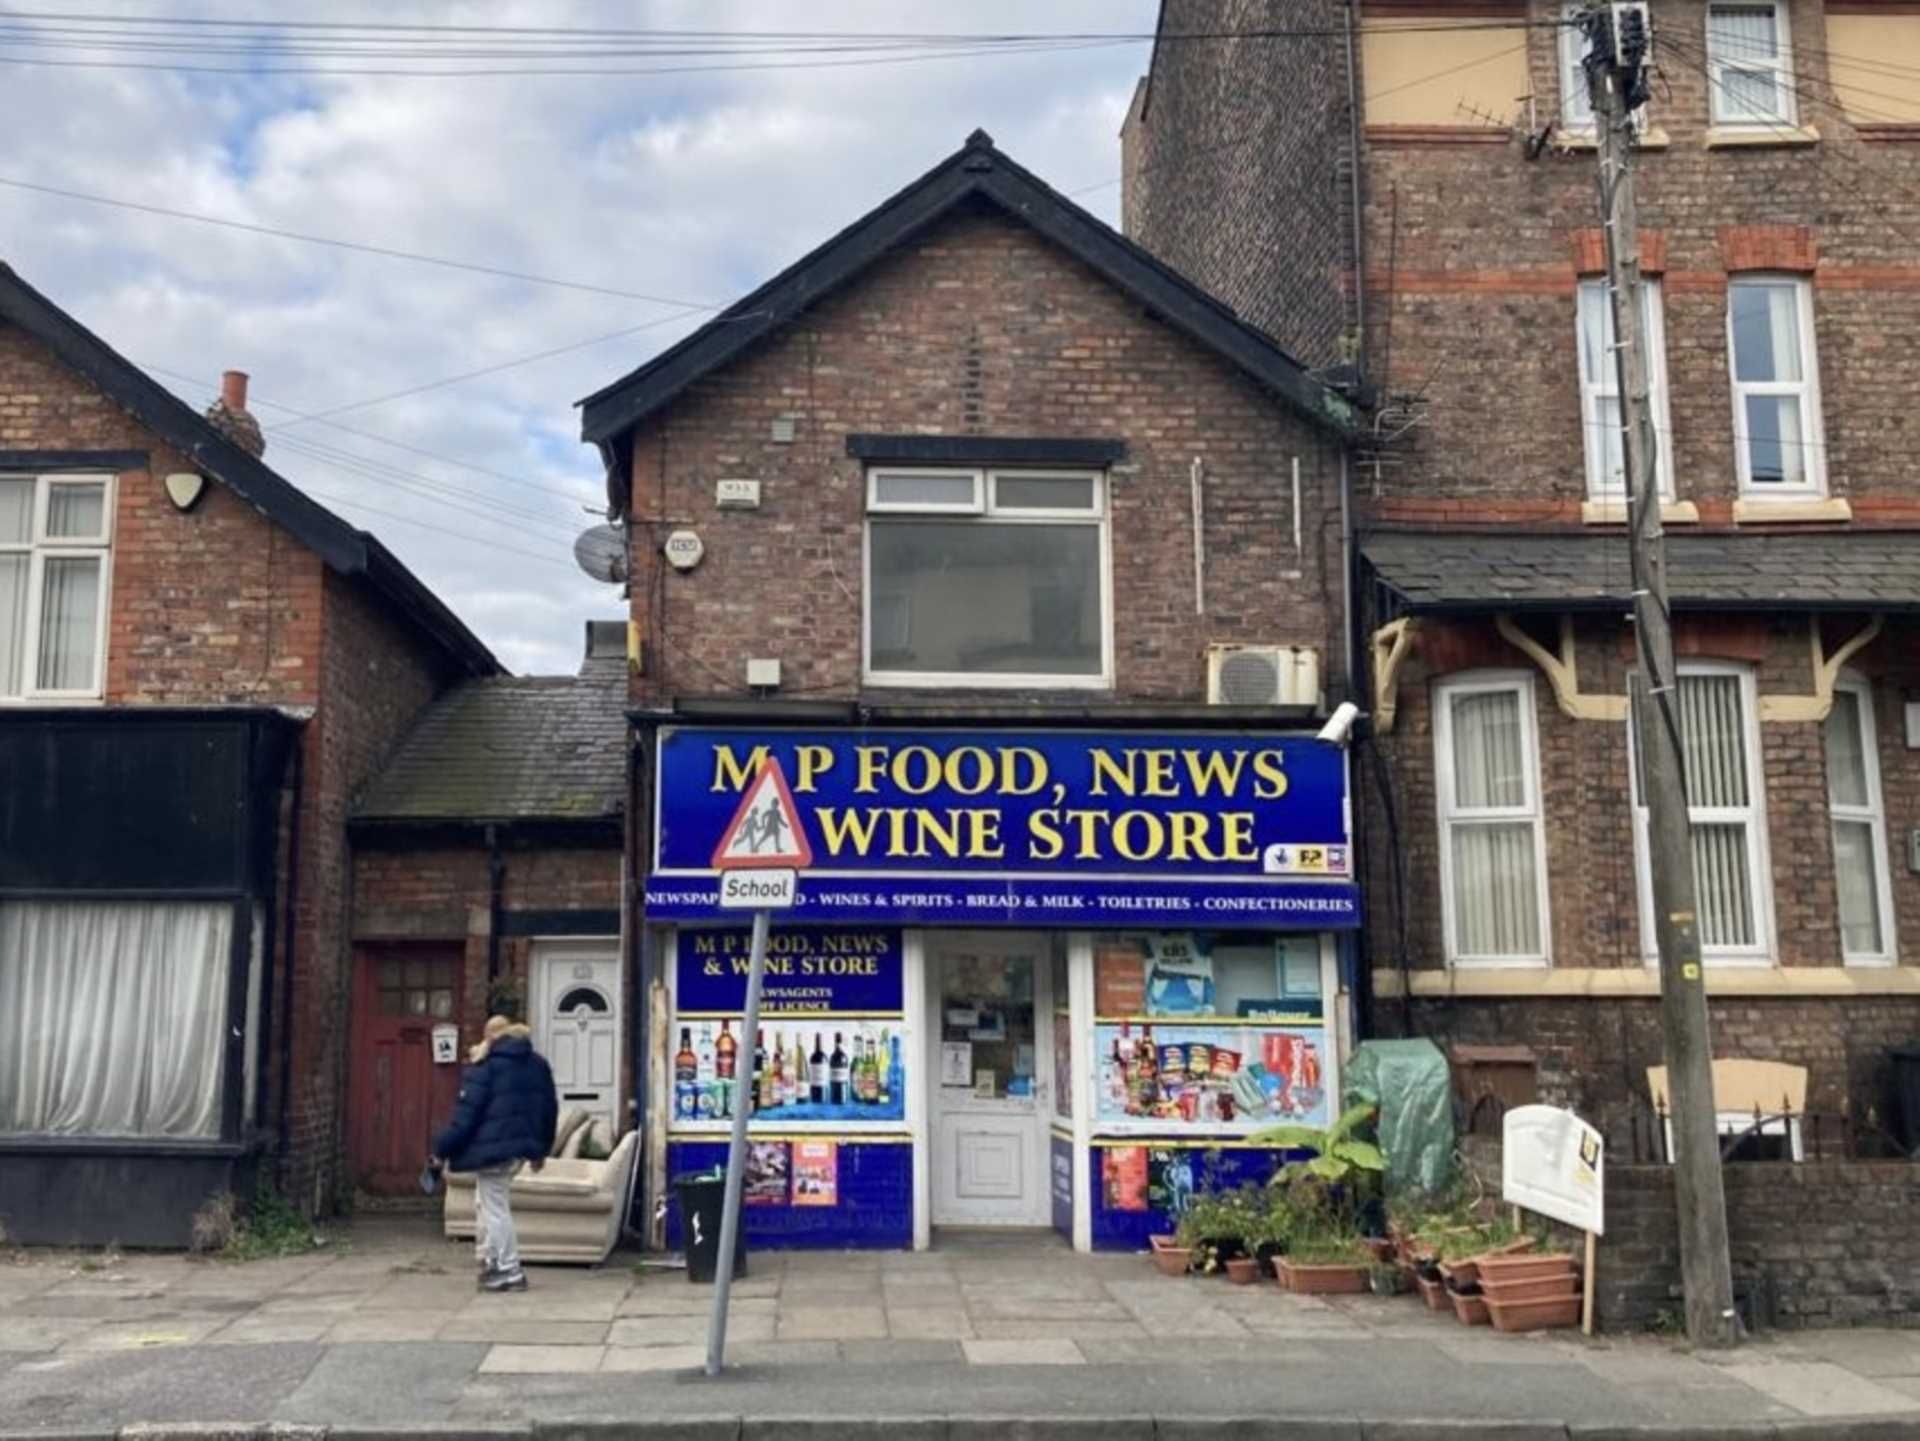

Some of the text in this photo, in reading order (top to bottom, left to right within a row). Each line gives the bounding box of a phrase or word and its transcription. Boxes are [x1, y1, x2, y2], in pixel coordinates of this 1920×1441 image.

[710, 744, 1289, 805] M P FOOD, NEWS
[814, 806, 1260, 862] WINE STORE
[726, 878, 788, 898] School
[645, 892, 719, 905] NEWSPAP
[819, 893, 871, 906] WINES
[874, 894, 888, 906] &
[892, 894, 954, 907] SPIRITS
[966, 894, 1020, 908] BREAD
[1024, 895, 1038, 908] &
[1042, 895, 1084, 908] MILK
[1098, 896, 1191, 910] TOILETRIES
[1203, 897, 1354, 912] CONFECTIONERIES
[695, 936, 715, 953] M
[723, 936, 737, 953] P
[822, 935, 889, 954] NEWS
[703, 956, 879, 976] & WNE STORE
